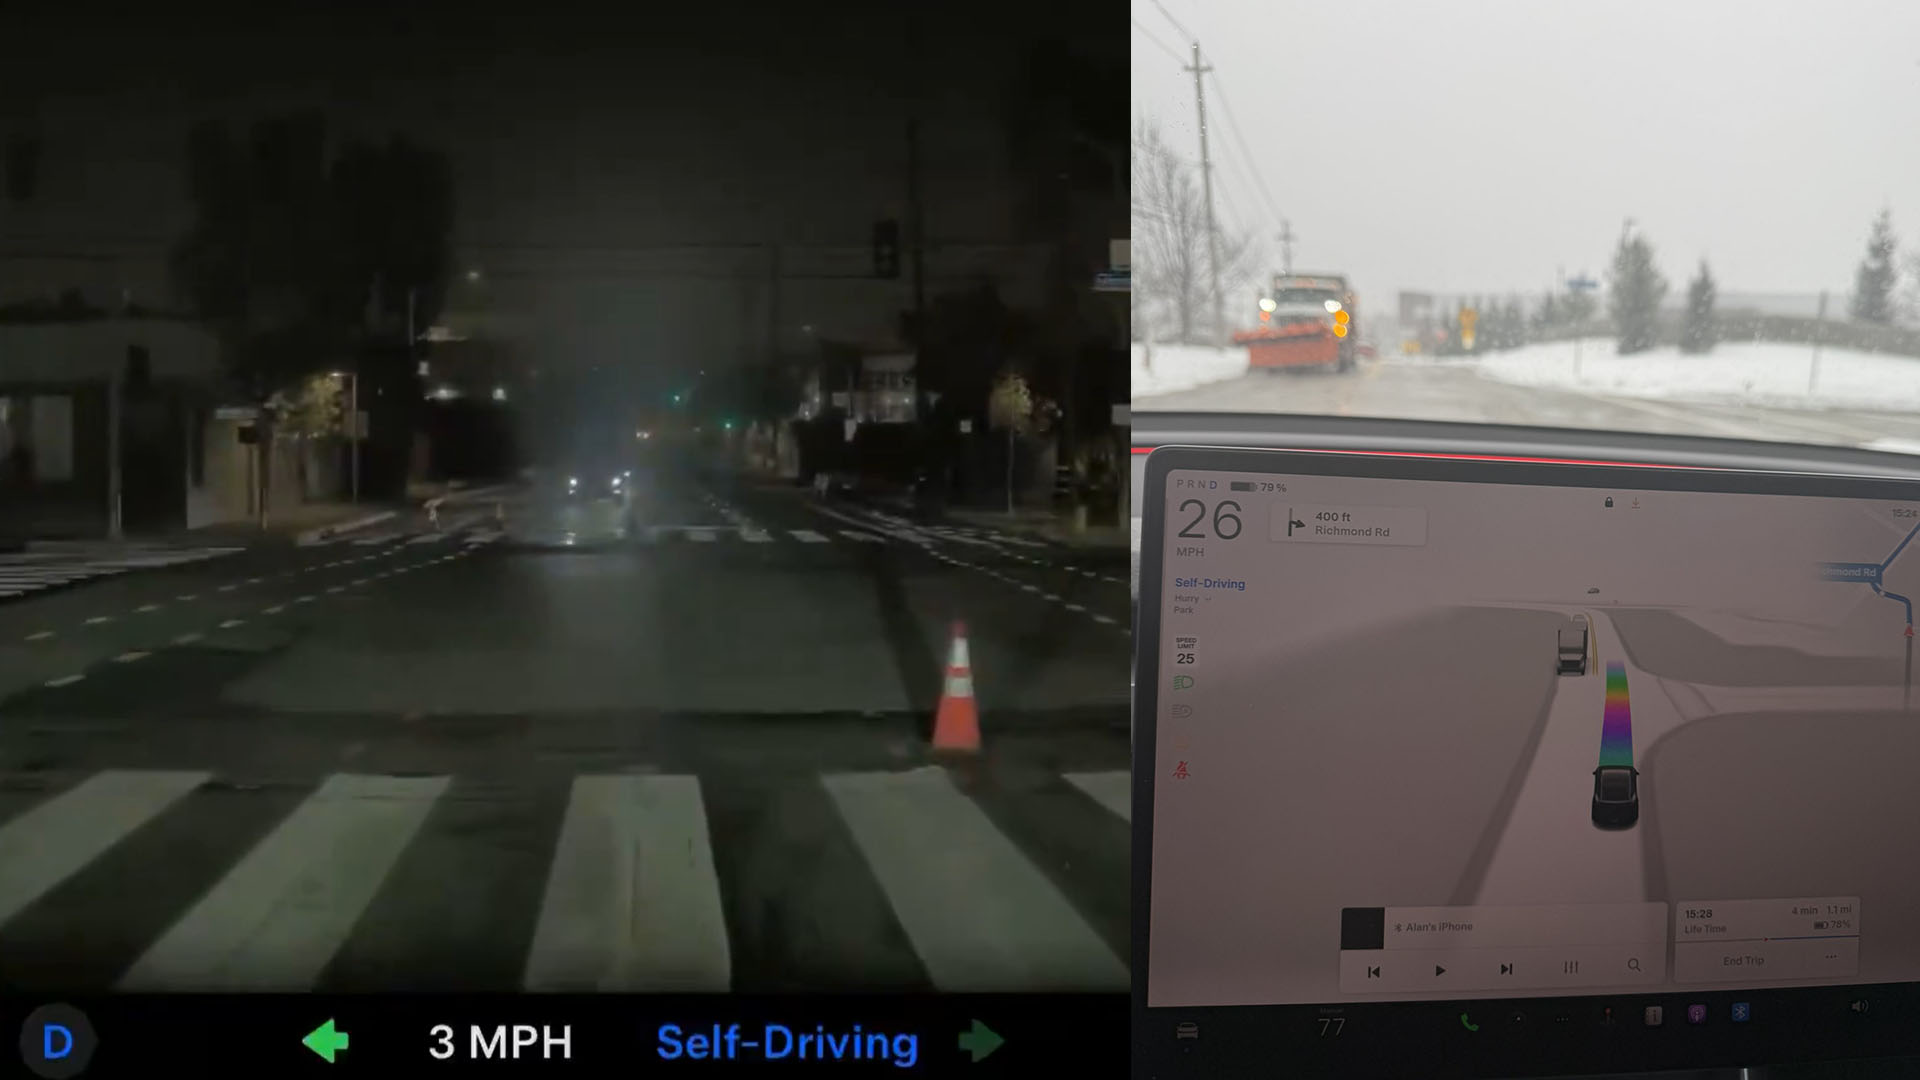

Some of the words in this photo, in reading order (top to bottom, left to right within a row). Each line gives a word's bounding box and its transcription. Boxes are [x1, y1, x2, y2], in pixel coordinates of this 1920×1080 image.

[1178, 499, 1242, 540] 26
[1315, 512, 1339, 521] 400
[1342, 512, 1351, 521] ft
[1315, 526, 1372, 537] Richmond
[1375, 527, 1390, 537] Rd
[1177, 547, 1204, 556] MPH
[1863, 567, 1876, 577] Rd
[1175, 577, 1246, 591] Self-Driving
[1175, 595, 1199, 604] Hurry
[1174, 606, 1193, 614] Park
[1177, 653, 1195, 664] 25
[1685, 909, 1713, 919] 15:28
[1800, 906, 1819, 915] min
[1827, 905, 1838, 914] 1.1
[1840, 904, 1852, 913] mi
[1406, 922, 1437, 932] Alan's
[1439, 921, 1474, 931] iPhone
[1685, 925, 1702, 934] Life
[1705, 924, 1727, 933] Time
[1723, 956, 1742, 966] End
[1745, 956, 1764, 968] Trip
[1318, 1018, 1345, 1036] 77
